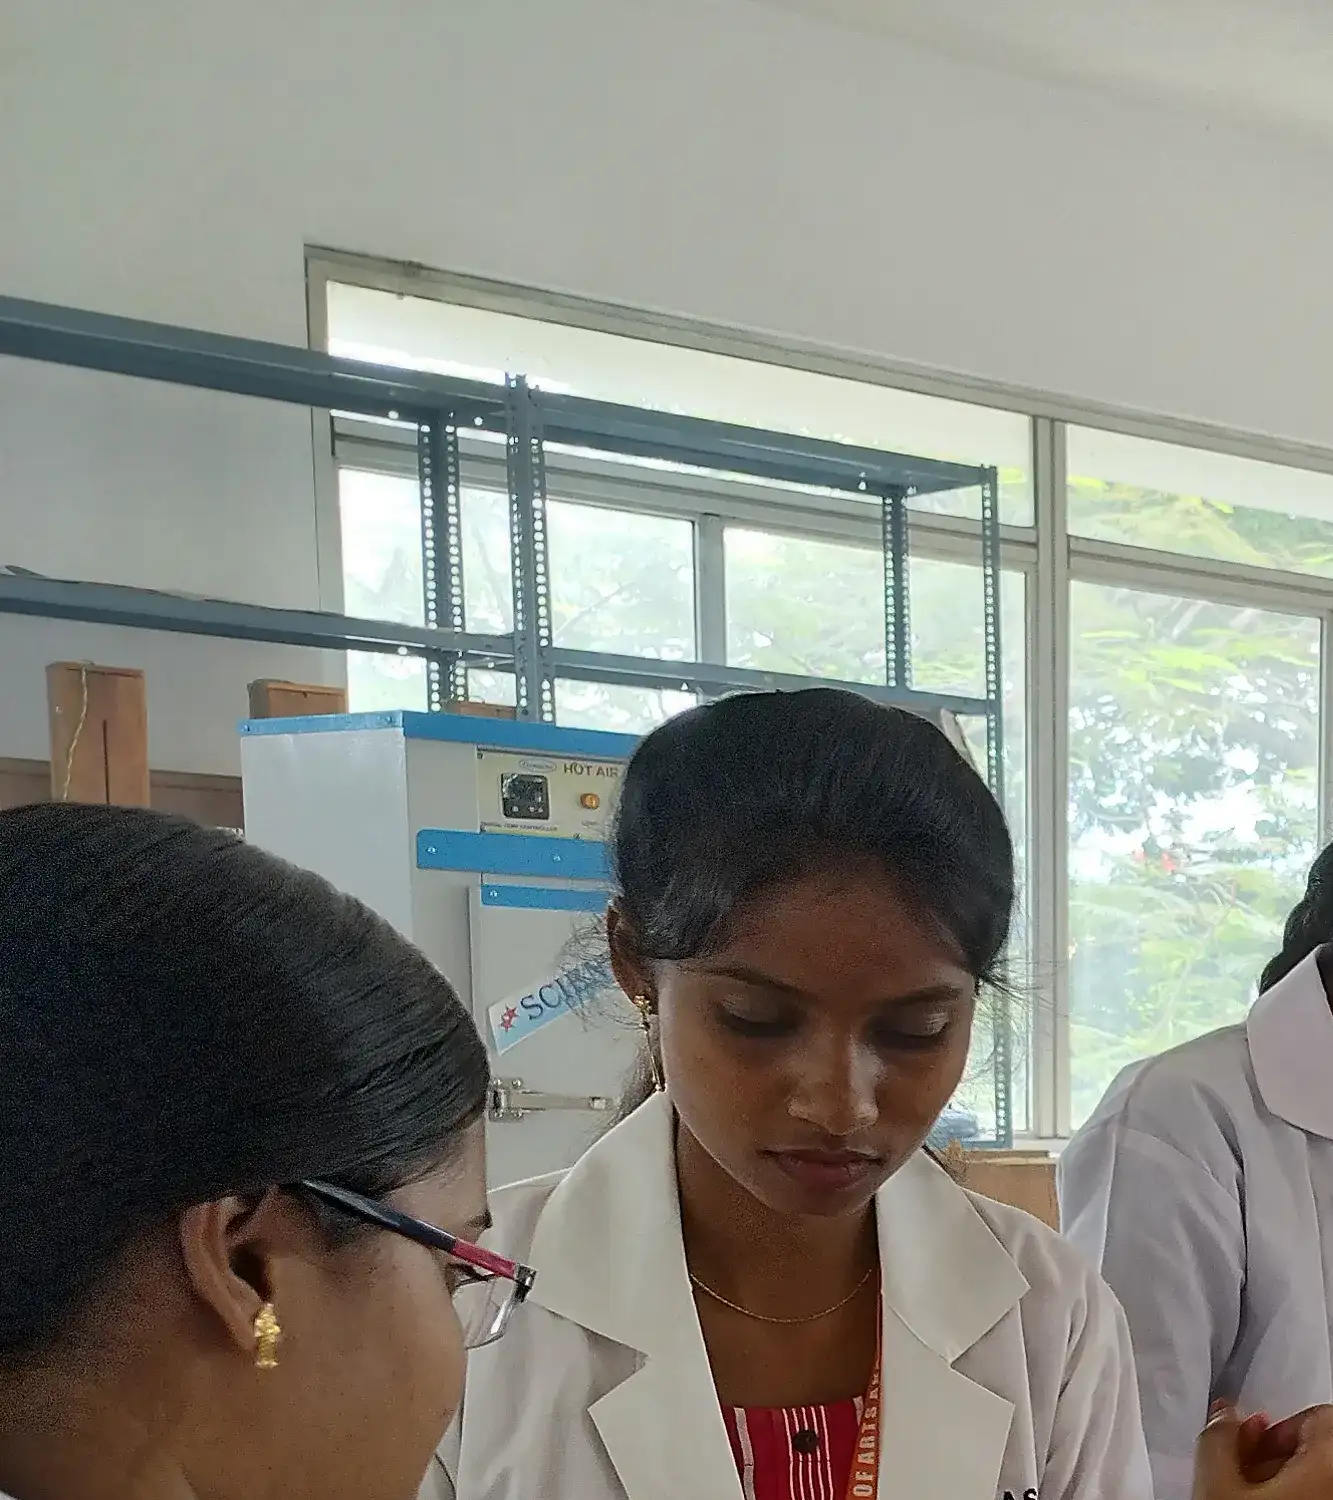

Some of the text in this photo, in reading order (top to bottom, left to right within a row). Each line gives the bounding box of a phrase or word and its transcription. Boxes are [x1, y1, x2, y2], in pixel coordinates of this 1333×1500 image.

[564, 762, 592, 777] HOT
[596, 767, 619, 778] AIR
[857, 1406, 878, 1465] ARTS
[852, 1470, 874, 1497] OF
